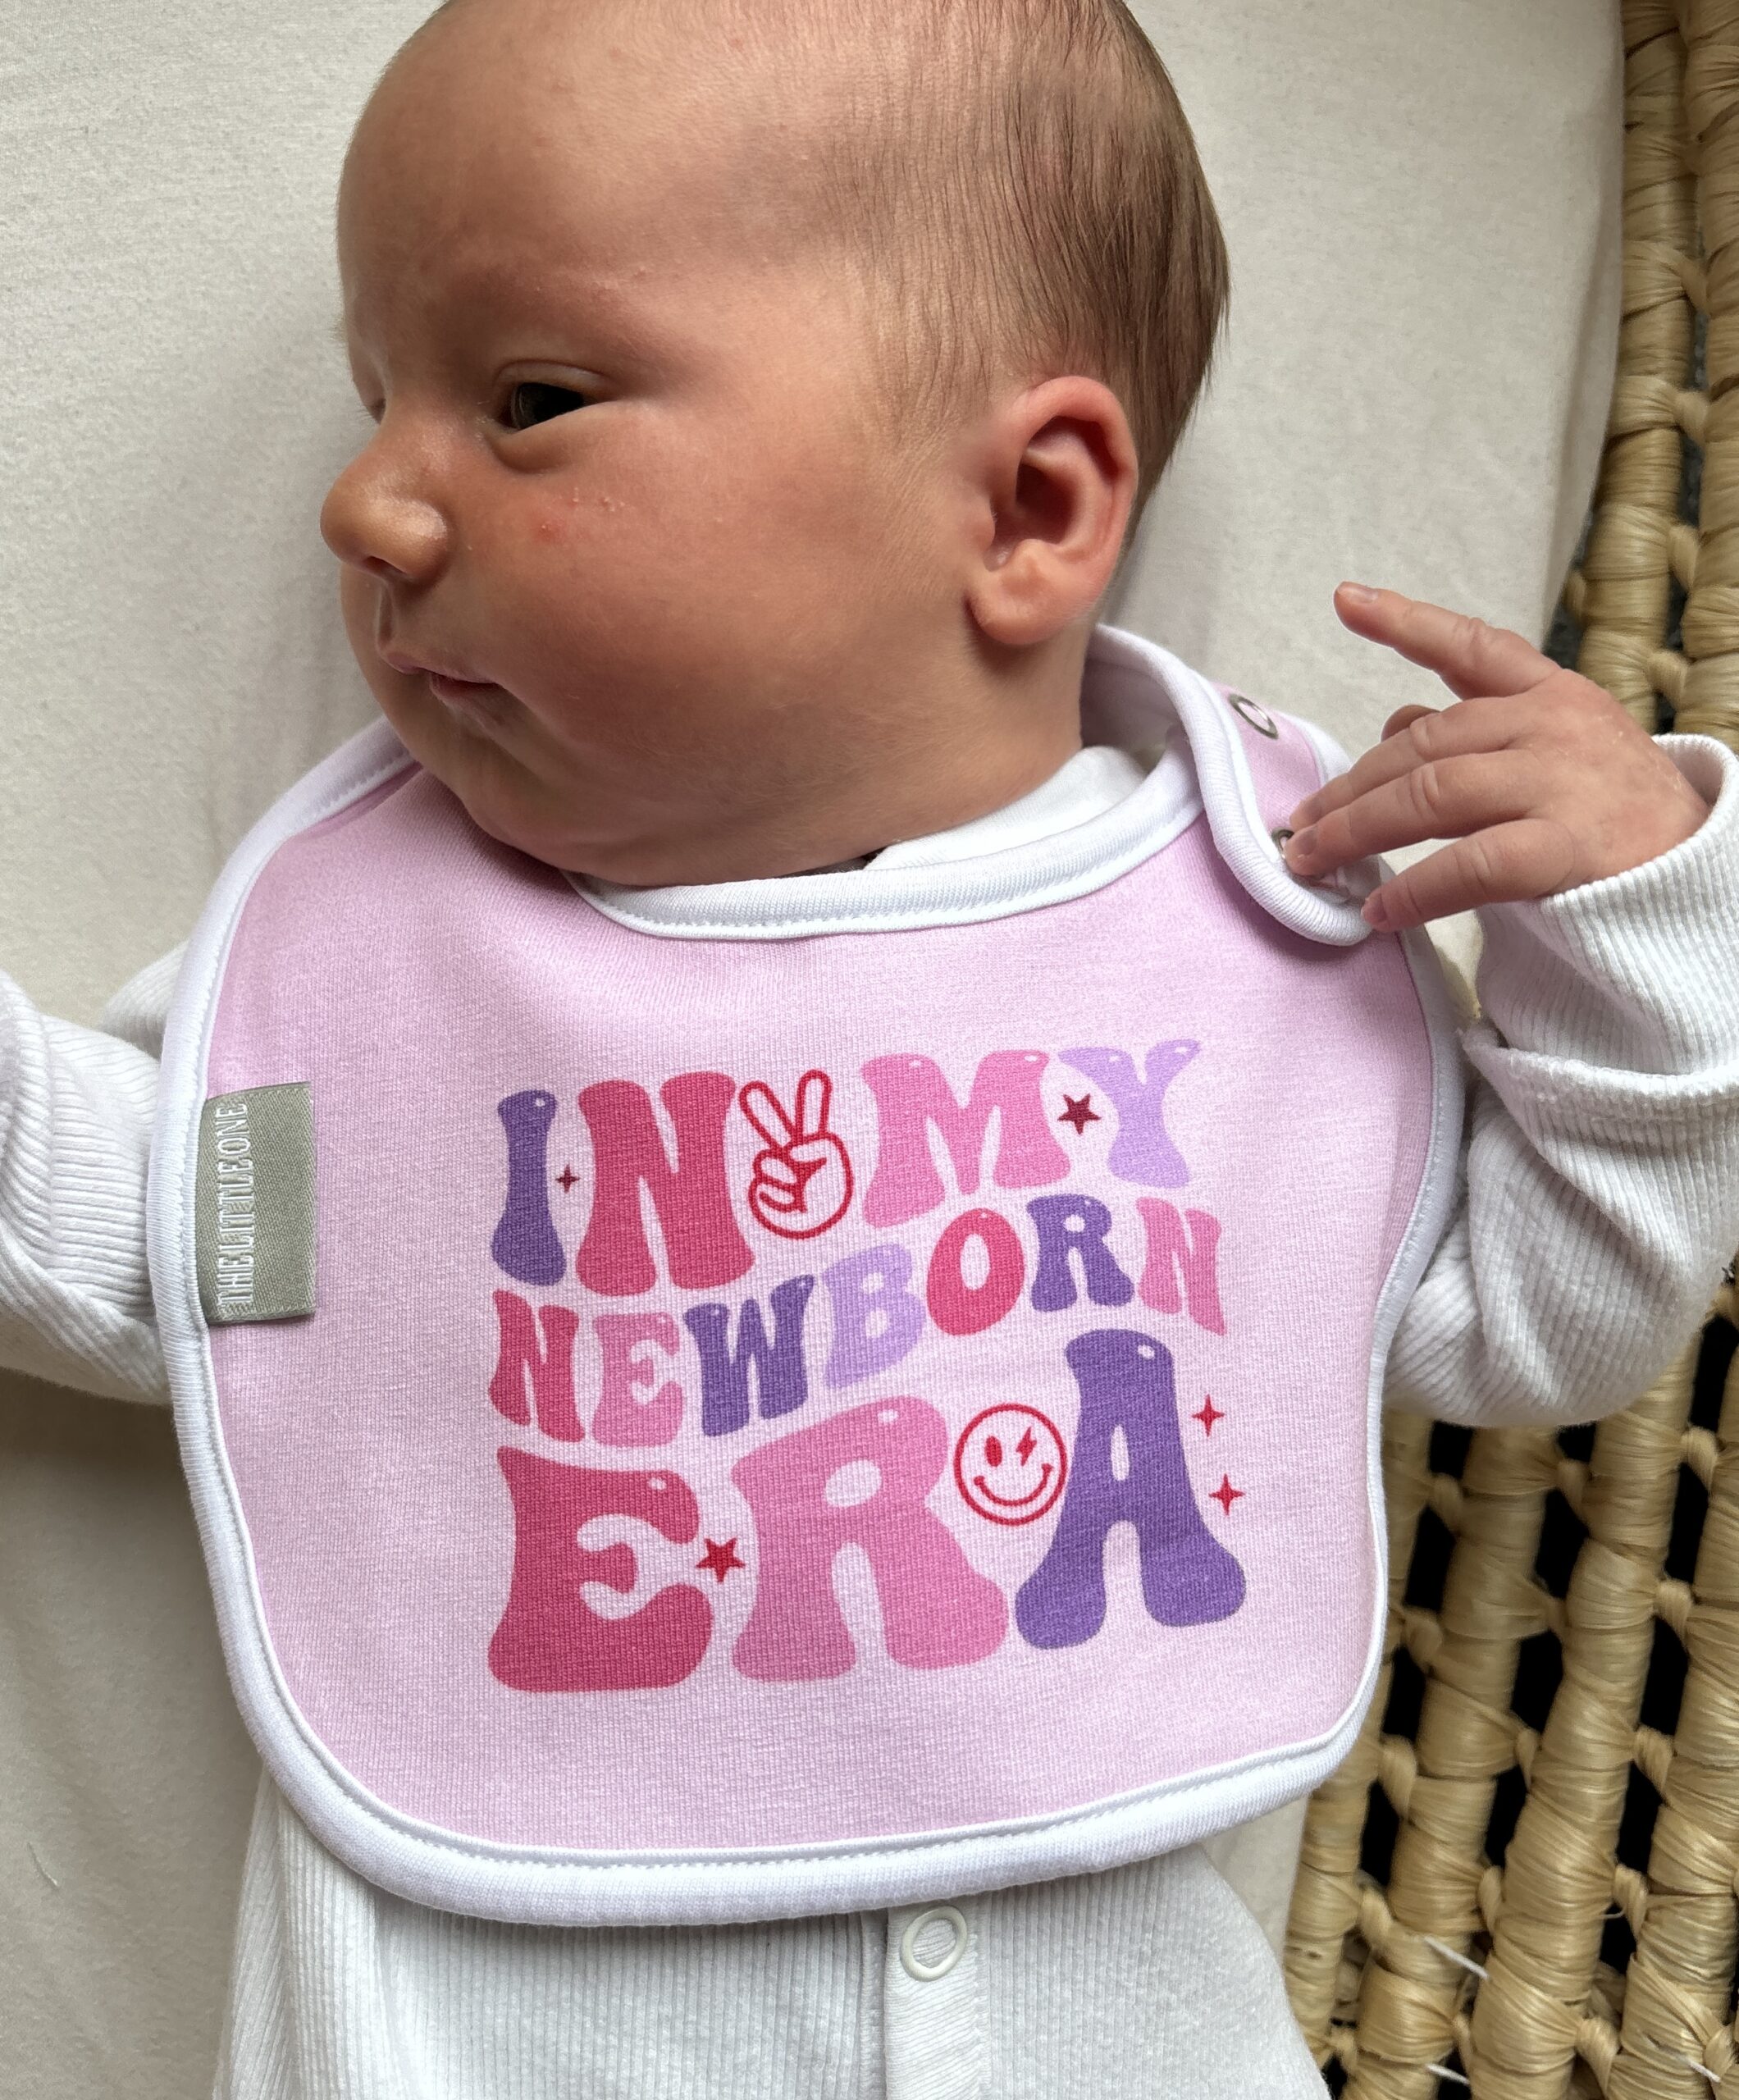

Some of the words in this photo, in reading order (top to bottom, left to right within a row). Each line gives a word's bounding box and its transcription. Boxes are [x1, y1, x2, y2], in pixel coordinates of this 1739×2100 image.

[491, 1071, 755, 1297] IN
[860, 1039, 1201, 1228] MY
[488, 1193, 1226, 1448] NEWBORN
[487, 1328, 1246, 1694] ERA
